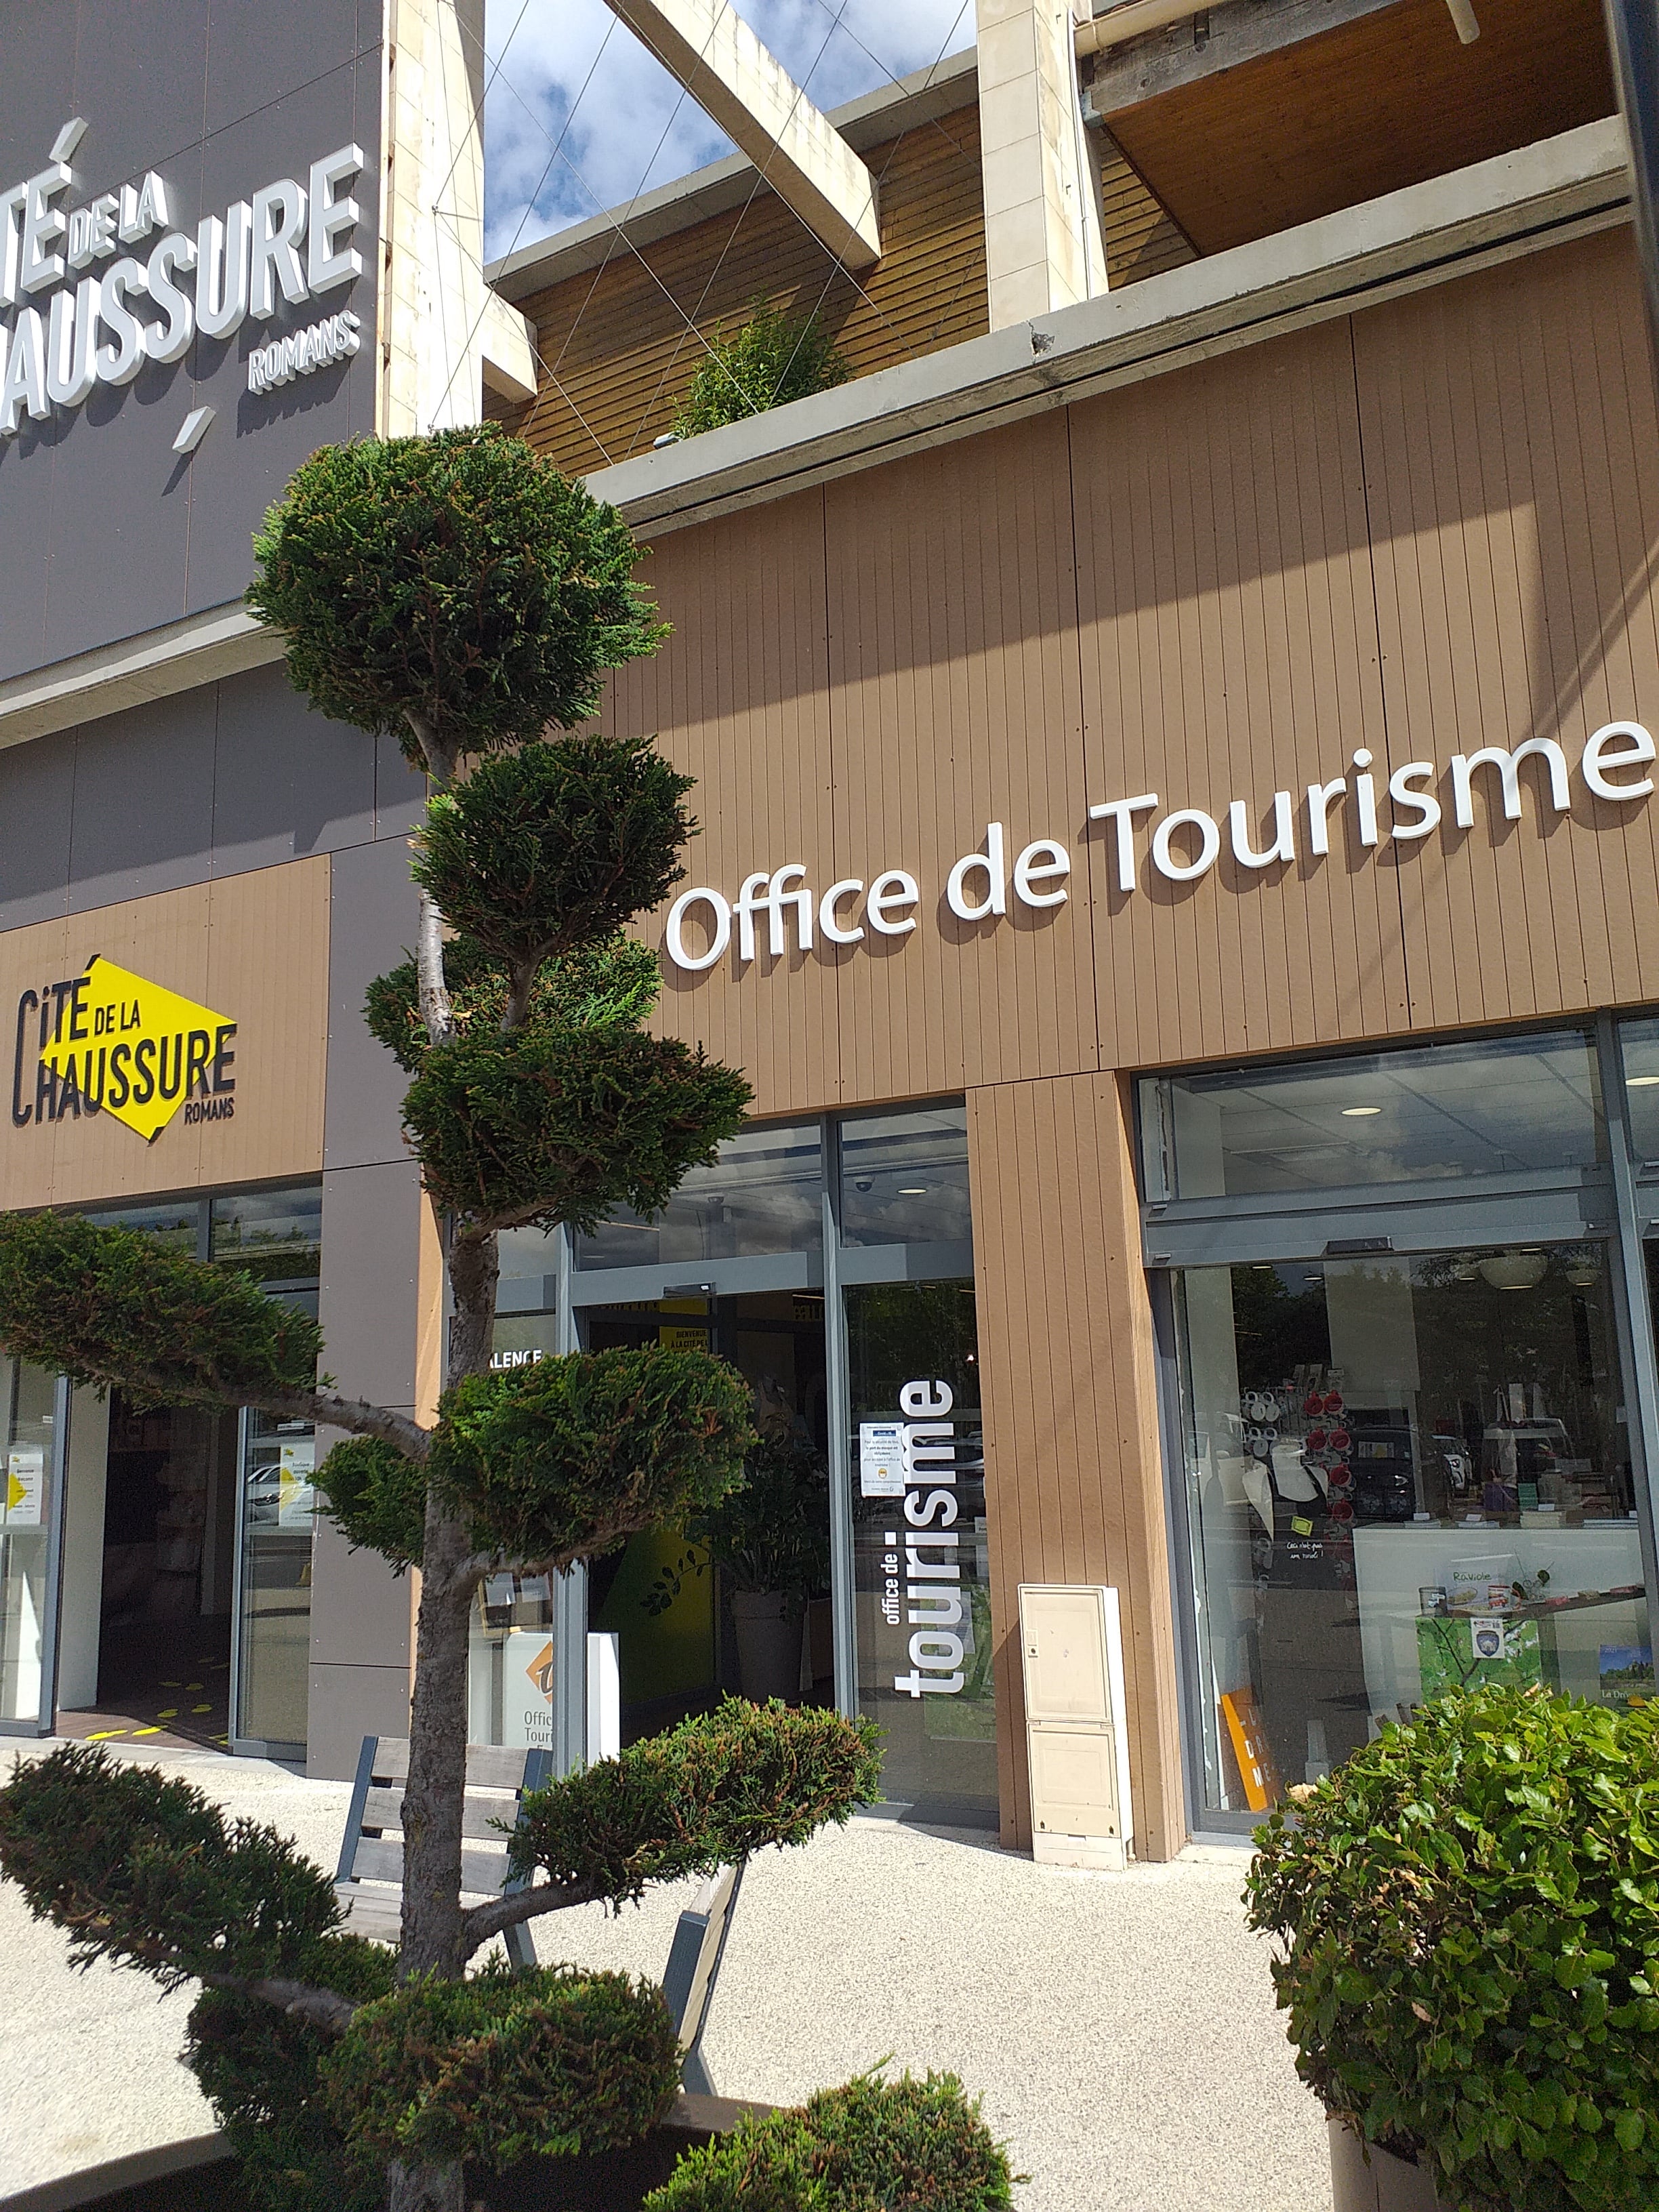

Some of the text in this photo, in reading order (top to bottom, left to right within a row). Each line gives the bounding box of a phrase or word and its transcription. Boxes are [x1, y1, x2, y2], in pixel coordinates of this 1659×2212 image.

[68, 193, 119, 270] DE
[119, 171, 169, 244] LA
[0, 142, 363, 435] AUSSURE
[247, 310, 361, 395] ROMANS
[666, 720, 1656, 970] Office de Tourisme
[94, 1003, 116, 1036] DE
[120, 999, 141, 1031] LA
[184, 1097, 235, 1126] ROMANS
[884, 1380, 965, 1699] tourisme
[1453, 1572, 1492, 1581] Raviole
[880, 1553, 900, 1625] office de
